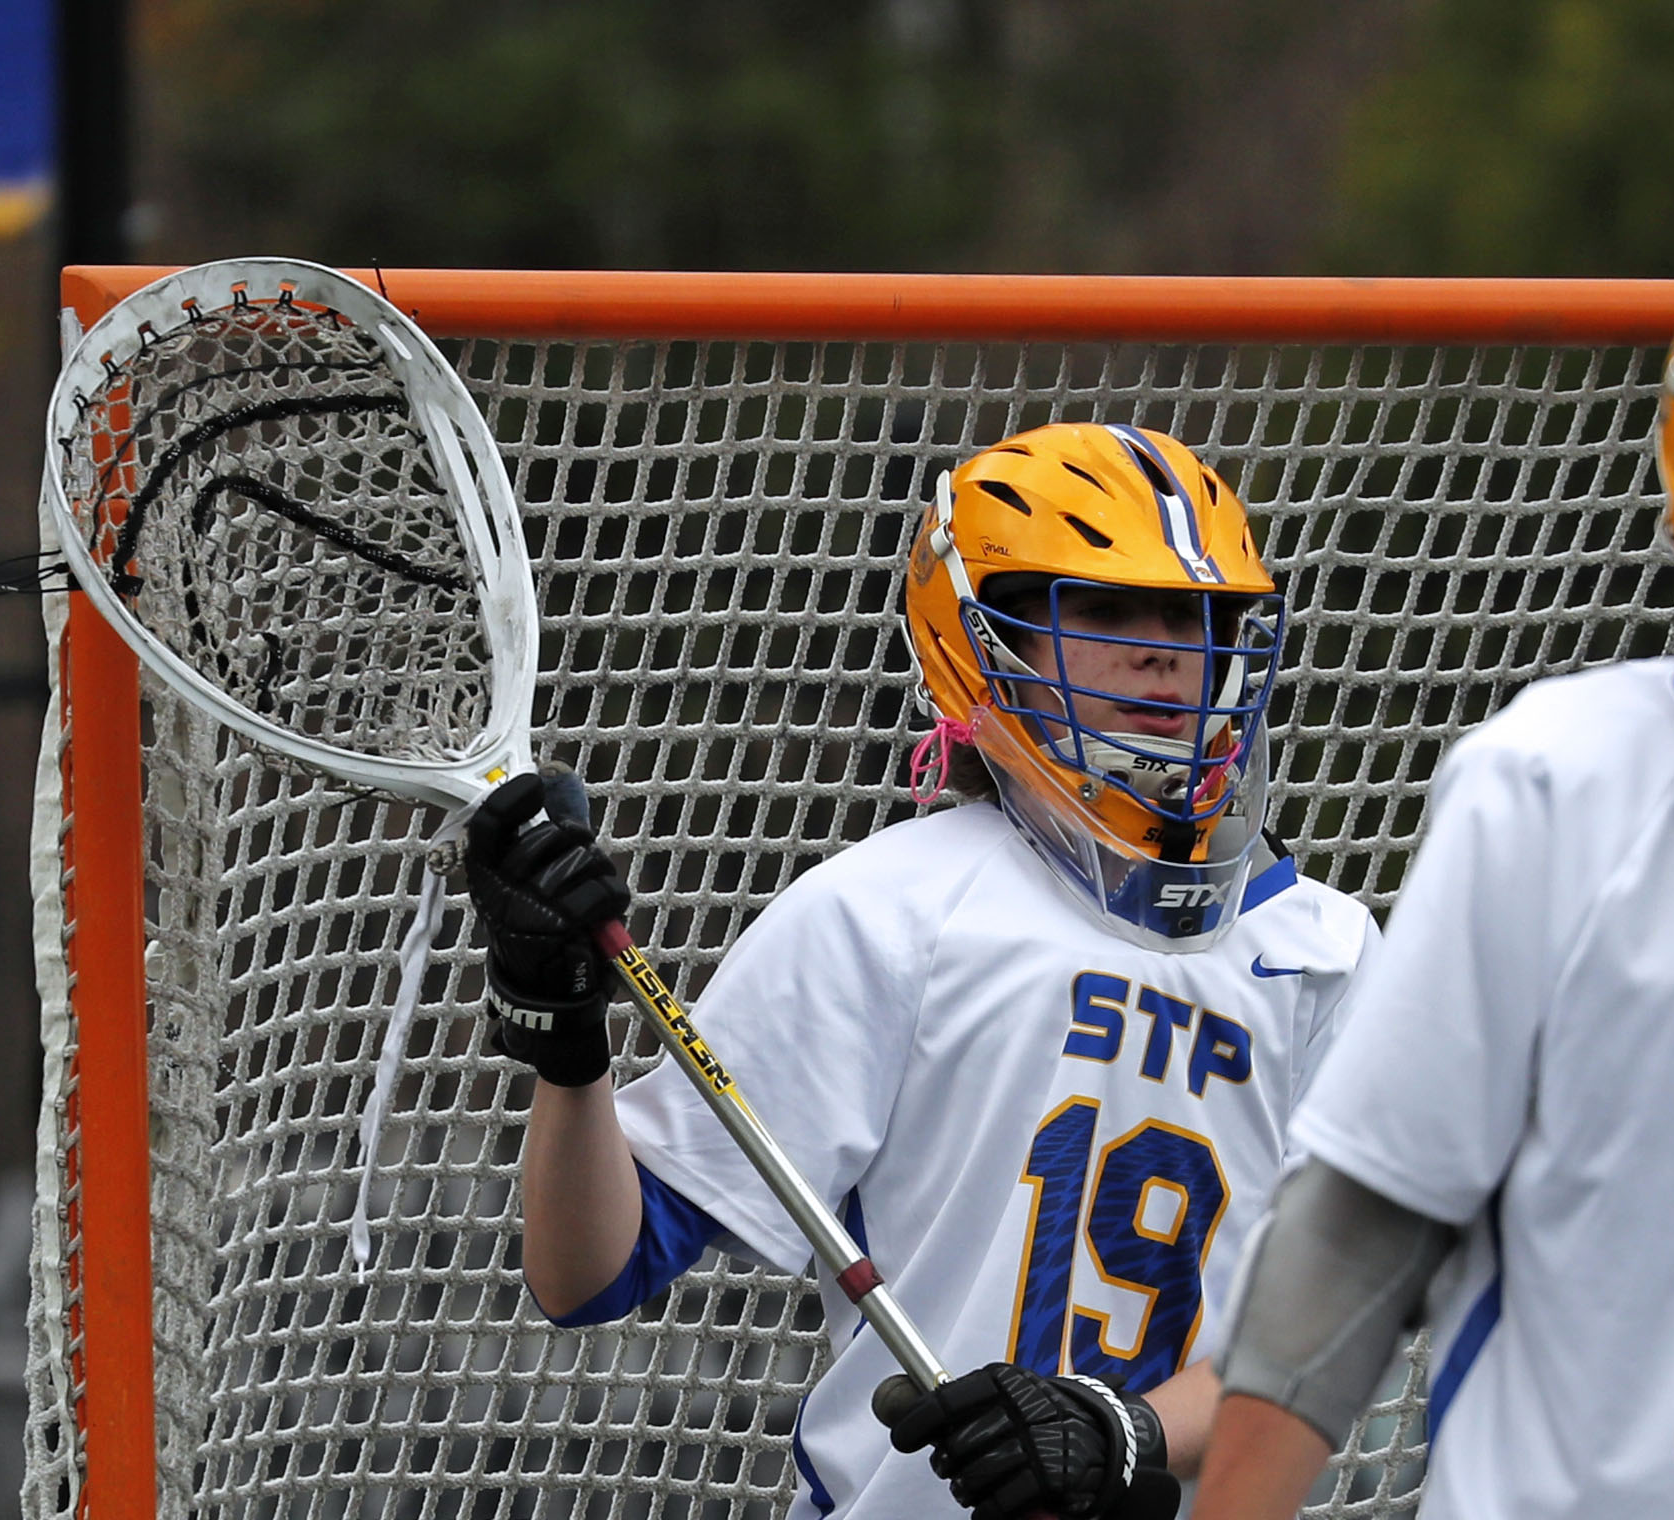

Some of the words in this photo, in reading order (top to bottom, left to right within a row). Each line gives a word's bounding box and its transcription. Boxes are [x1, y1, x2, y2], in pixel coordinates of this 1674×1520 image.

[968, 611, 1000, 652] STX
[1132, 757, 1169, 773] STX
[1153, 880, 1232, 908] STX
[1061, 968, 1254, 1100] STP
[1005, 1092, 1233, 1394] 19
